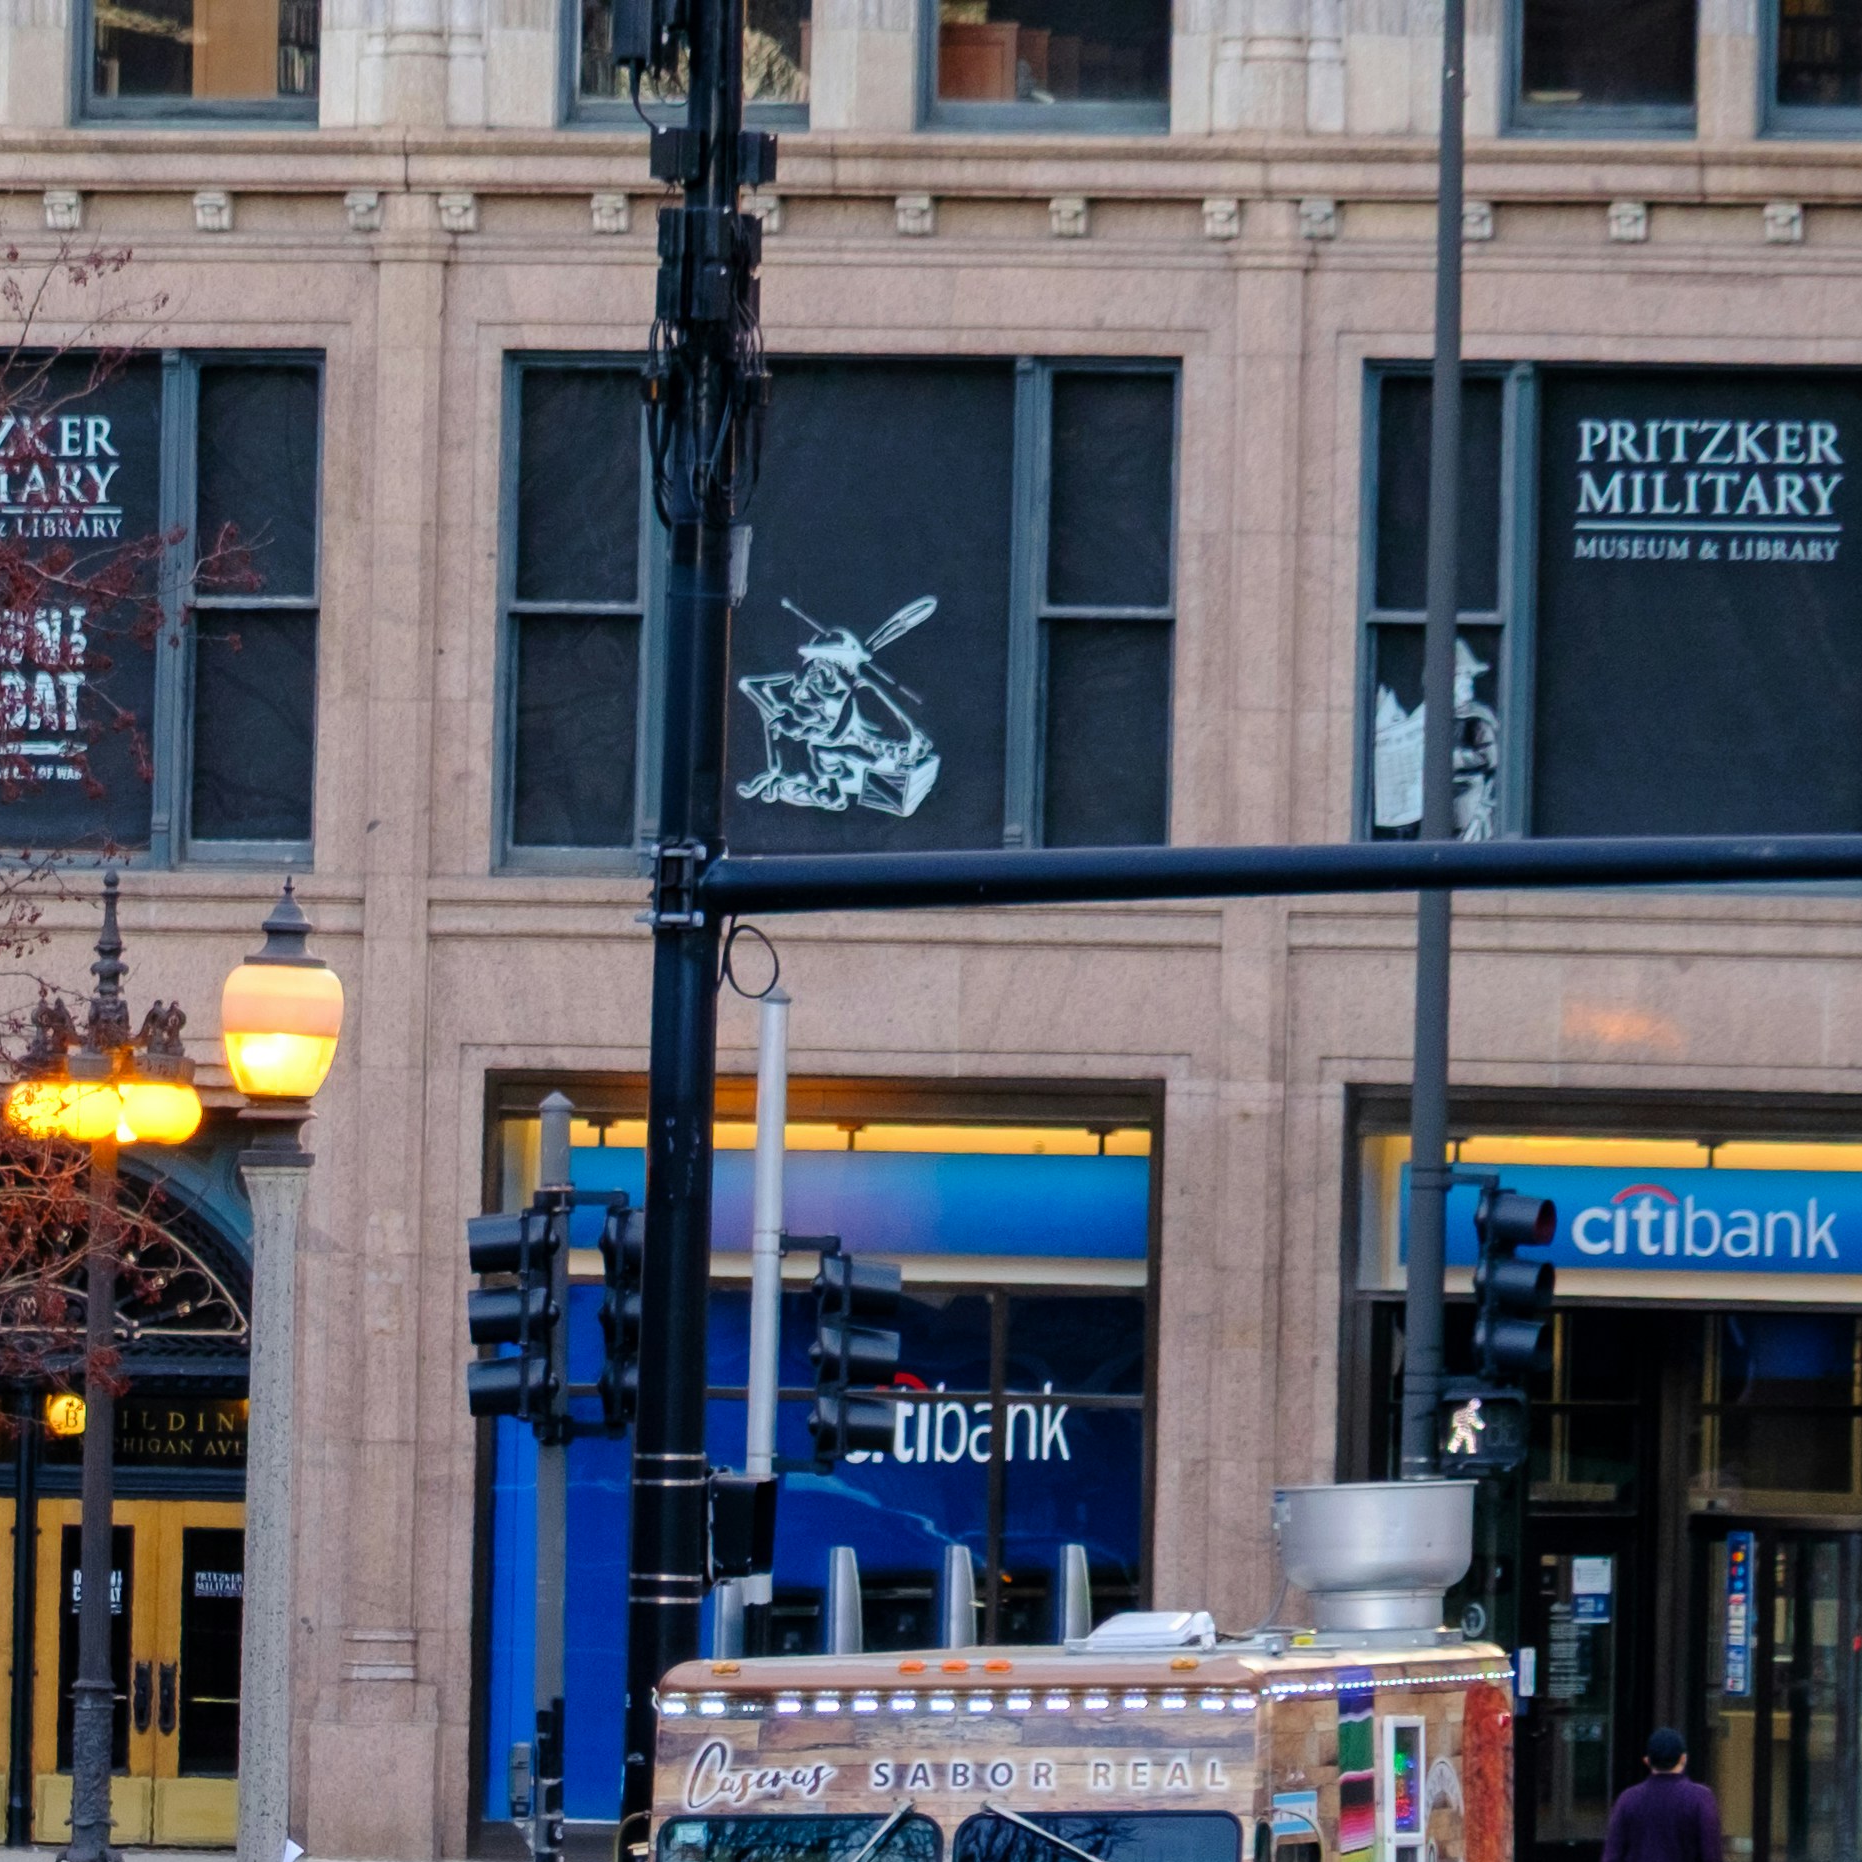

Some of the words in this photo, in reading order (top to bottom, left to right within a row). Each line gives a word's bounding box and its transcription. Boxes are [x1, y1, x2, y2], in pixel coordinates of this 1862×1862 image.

[1578, 418, 1844, 466] PRITZKER
[1576, 471, 1844, 517] MILITARY
[1574, 536, 1691, 561] MUSEUM
[1698, 539, 1721, 561] &
[1728, 540, 1840, 562] LIBRARY
[1571, 1194, 1840, 1260] citibank
[844, 1382, 1072, 1465] tibank
[872, 1760, 1055, 1789] SABOR
[1091, 1760, 1228, 1789] REAL
